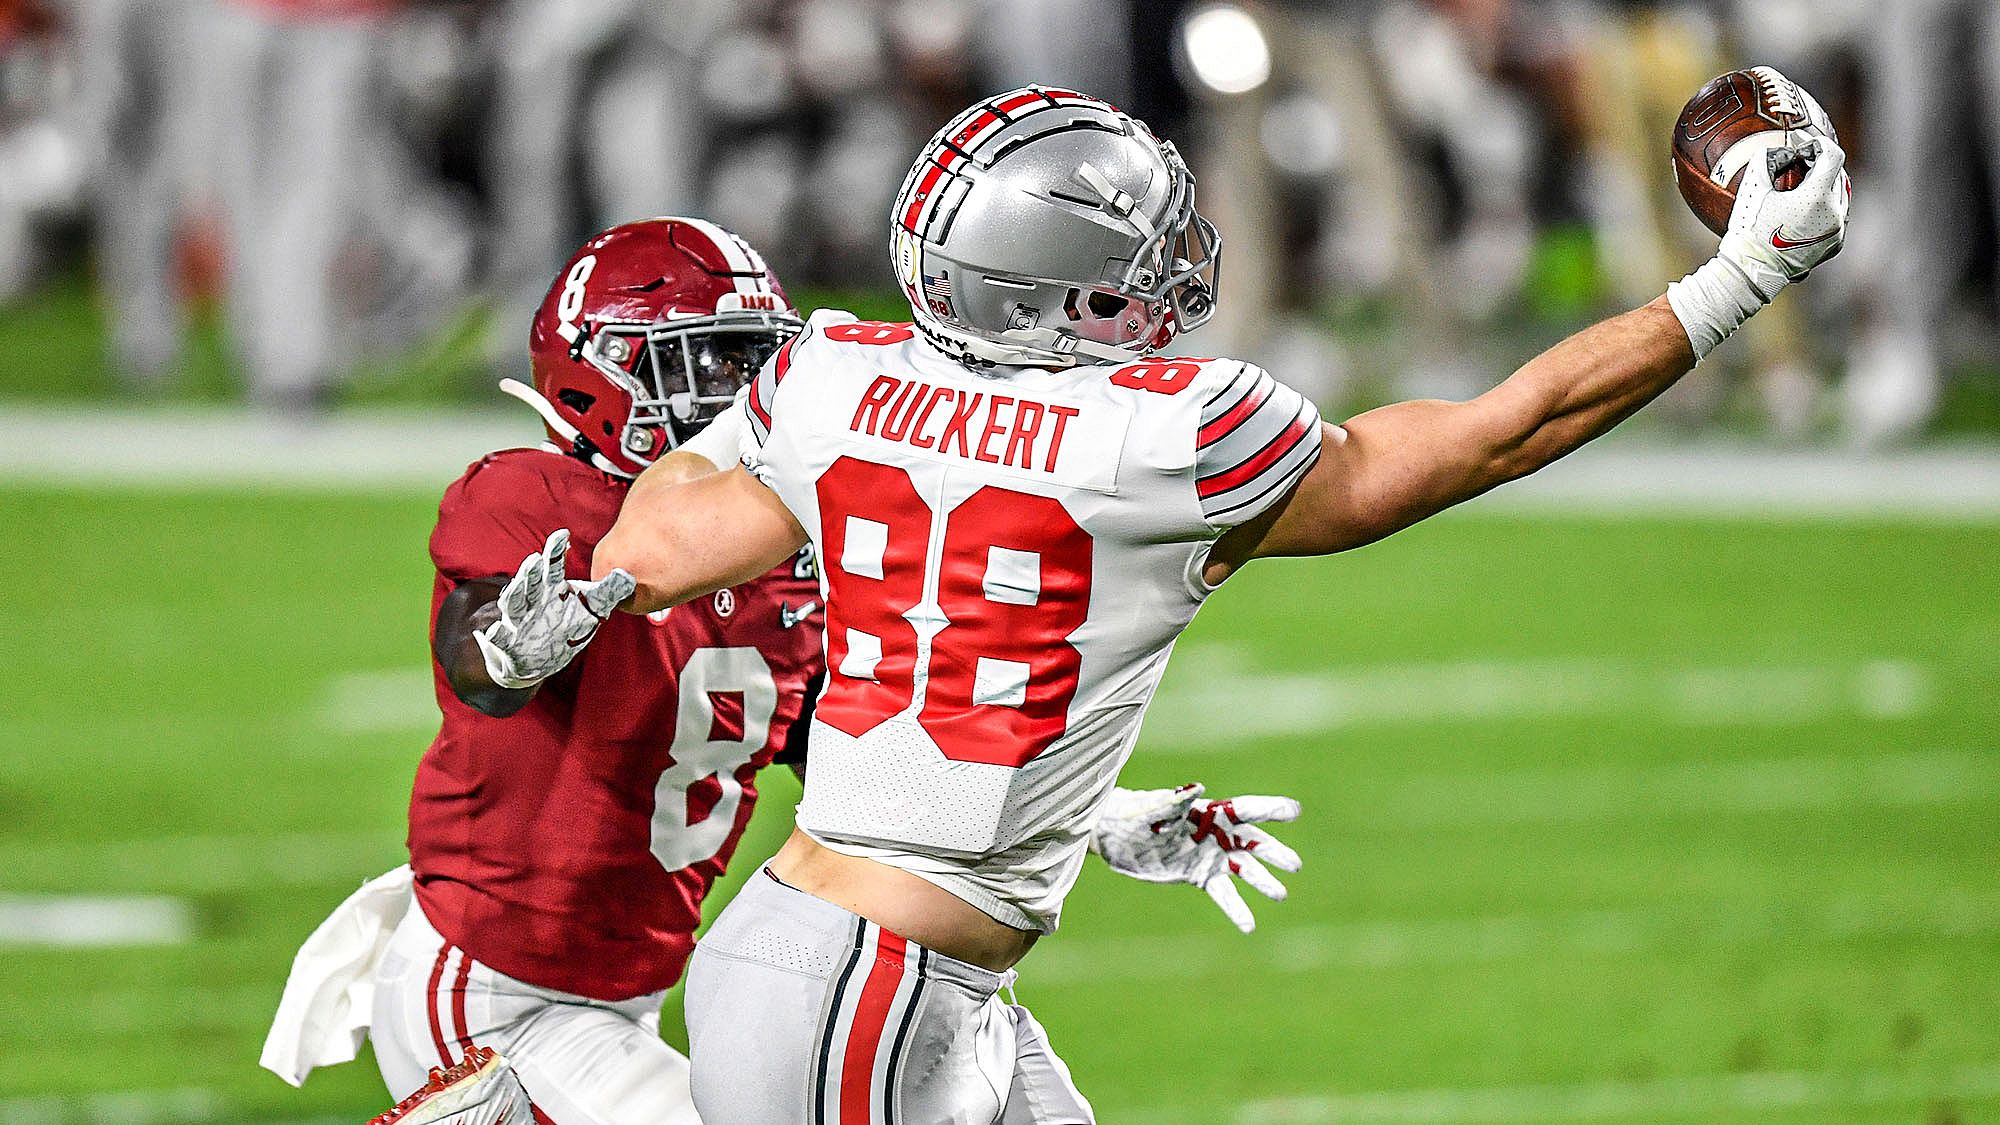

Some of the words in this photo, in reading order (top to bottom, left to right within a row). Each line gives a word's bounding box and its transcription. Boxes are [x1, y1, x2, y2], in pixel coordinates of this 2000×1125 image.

[558, 254, 597, 322] 8
[928, 298, 950, 317] 88
[850, 374, 1080, 473] RUCKERT
[815, 455, 1094, 769] 88
[650, 646, 778, 873] 8
